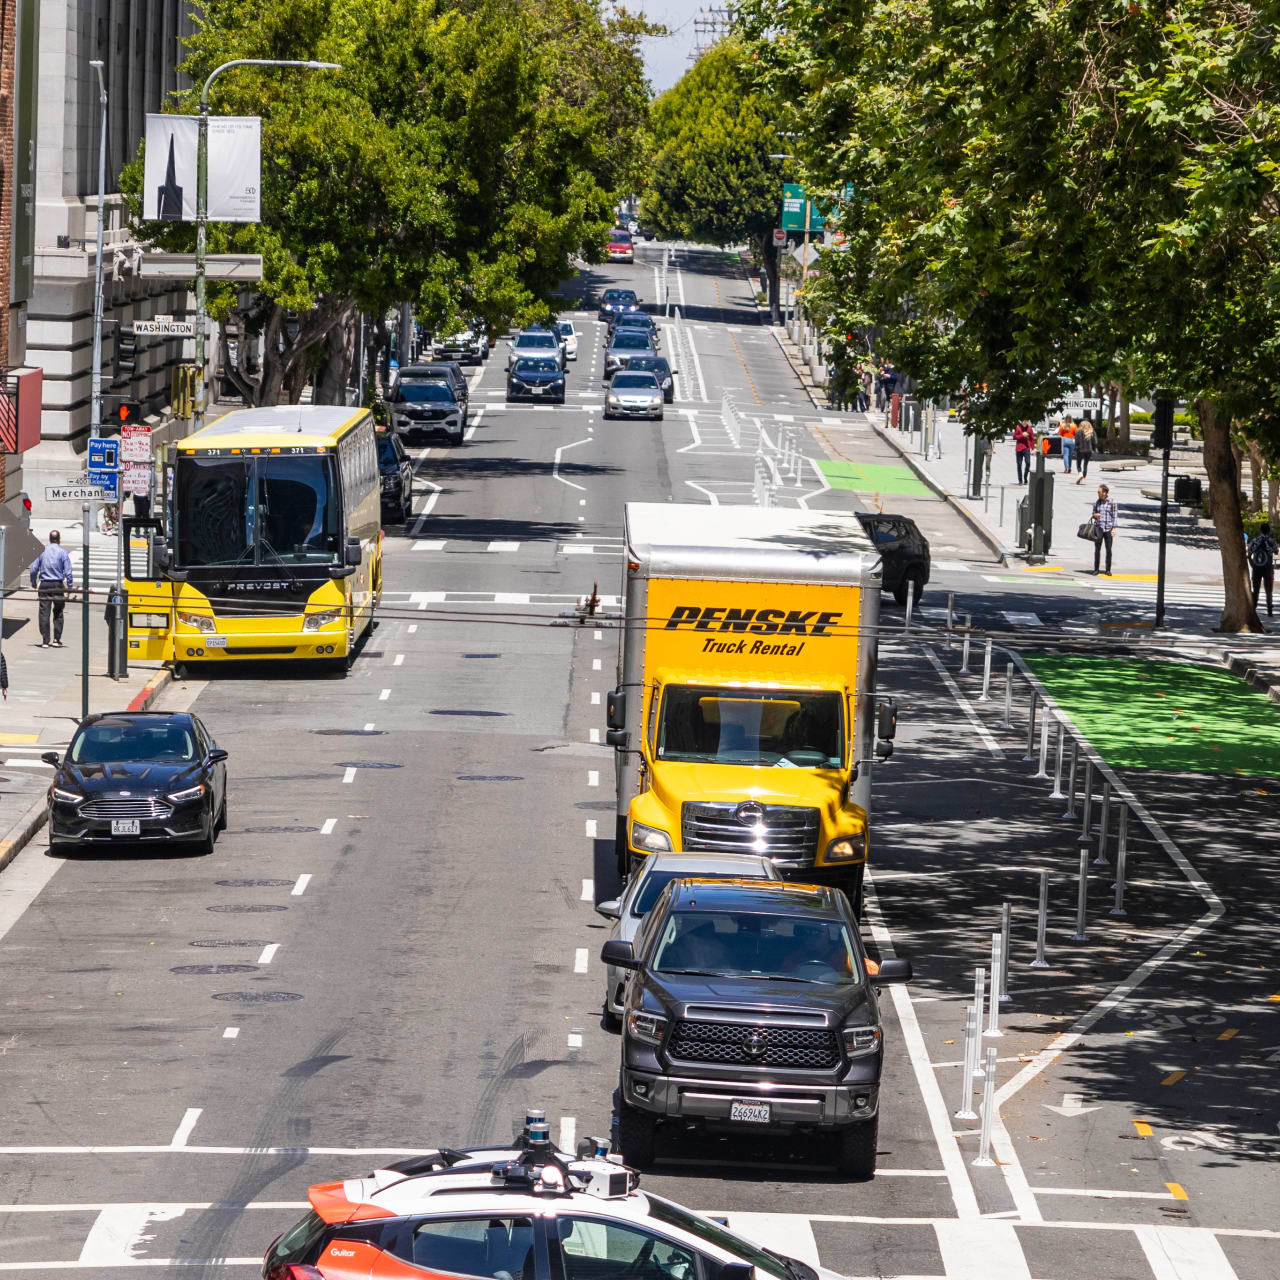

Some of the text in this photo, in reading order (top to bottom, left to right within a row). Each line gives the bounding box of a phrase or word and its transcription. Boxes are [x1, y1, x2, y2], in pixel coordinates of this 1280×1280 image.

[135, 323, 192, 333] WASHINGTON
[52, 488, 103, 498] Merchant
[227, 582, 289, 590] PREVOST
[664, 606, 844, 637] PENSKE
[702, 638, 806, 657] Truck Rental
[732, 1106, 768, 1120] 26694K2
[330, 1248, 355, 1257] Guitar
